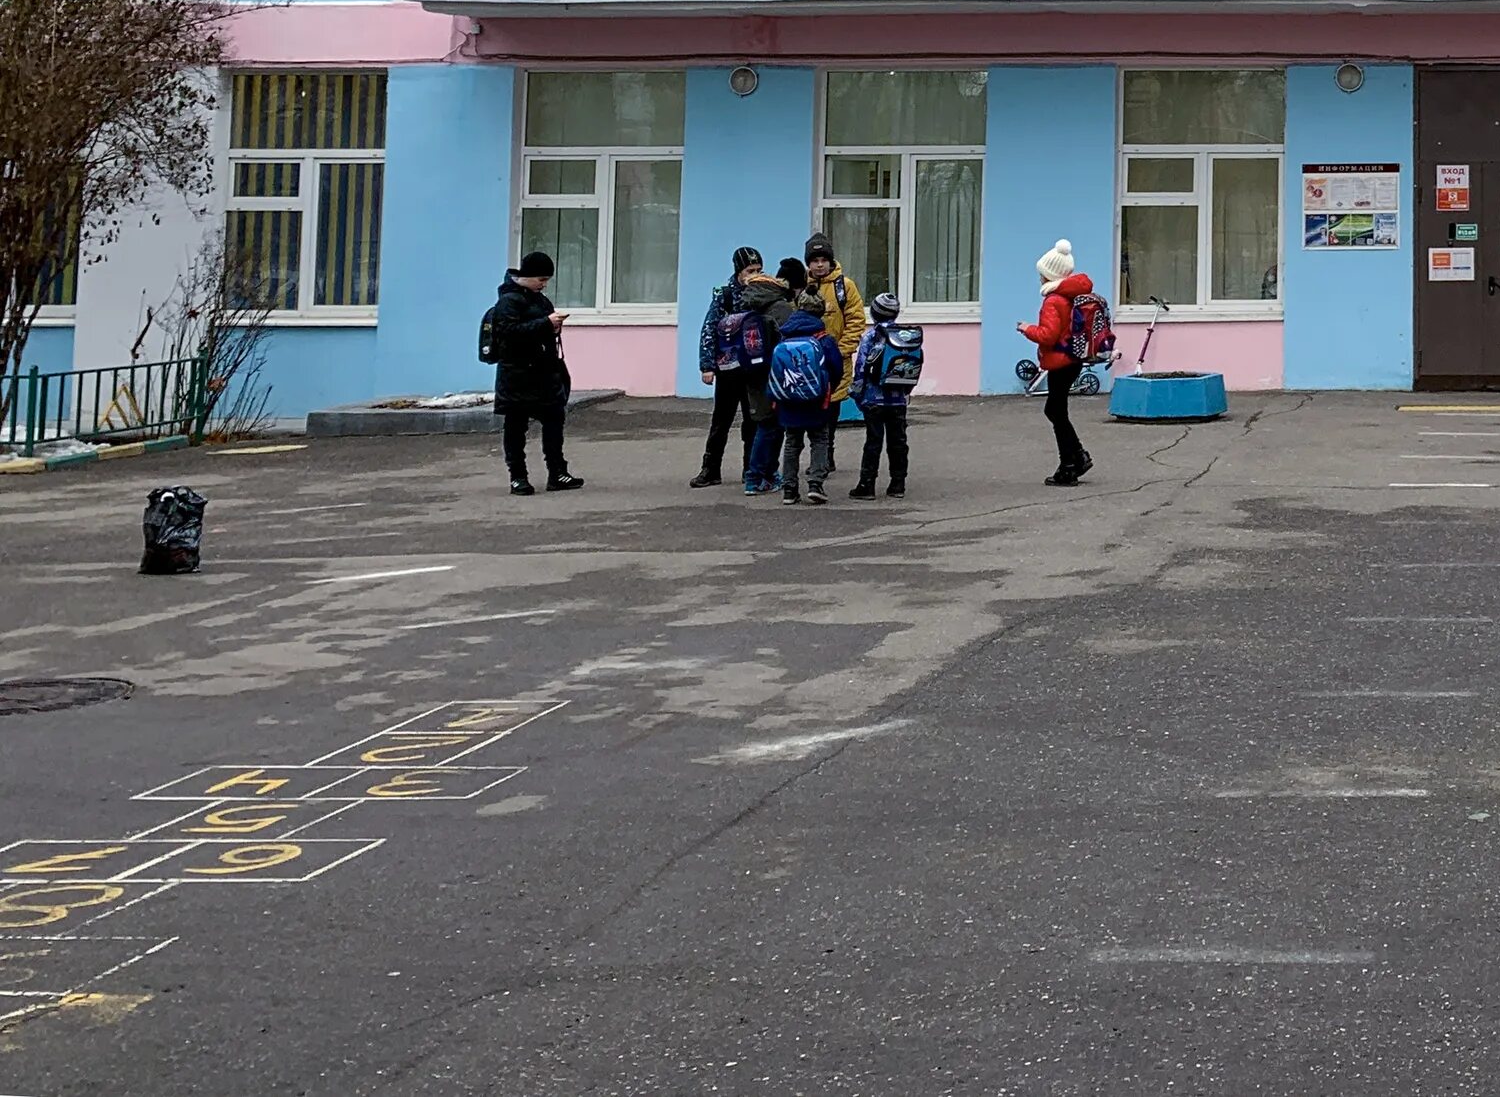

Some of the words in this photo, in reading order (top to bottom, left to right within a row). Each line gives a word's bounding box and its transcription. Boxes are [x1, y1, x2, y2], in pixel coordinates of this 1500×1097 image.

[1441, 168, 1465, 176] ВХОД
[1444, 177, 1461, 185] №1
[360, 735, 471, 763] 2
[204, 769, 290, 794] 4
[366, 769, 470, 797] 3
[180, 804, 300, 833] 5
[2, 846, 128, 873] 7
